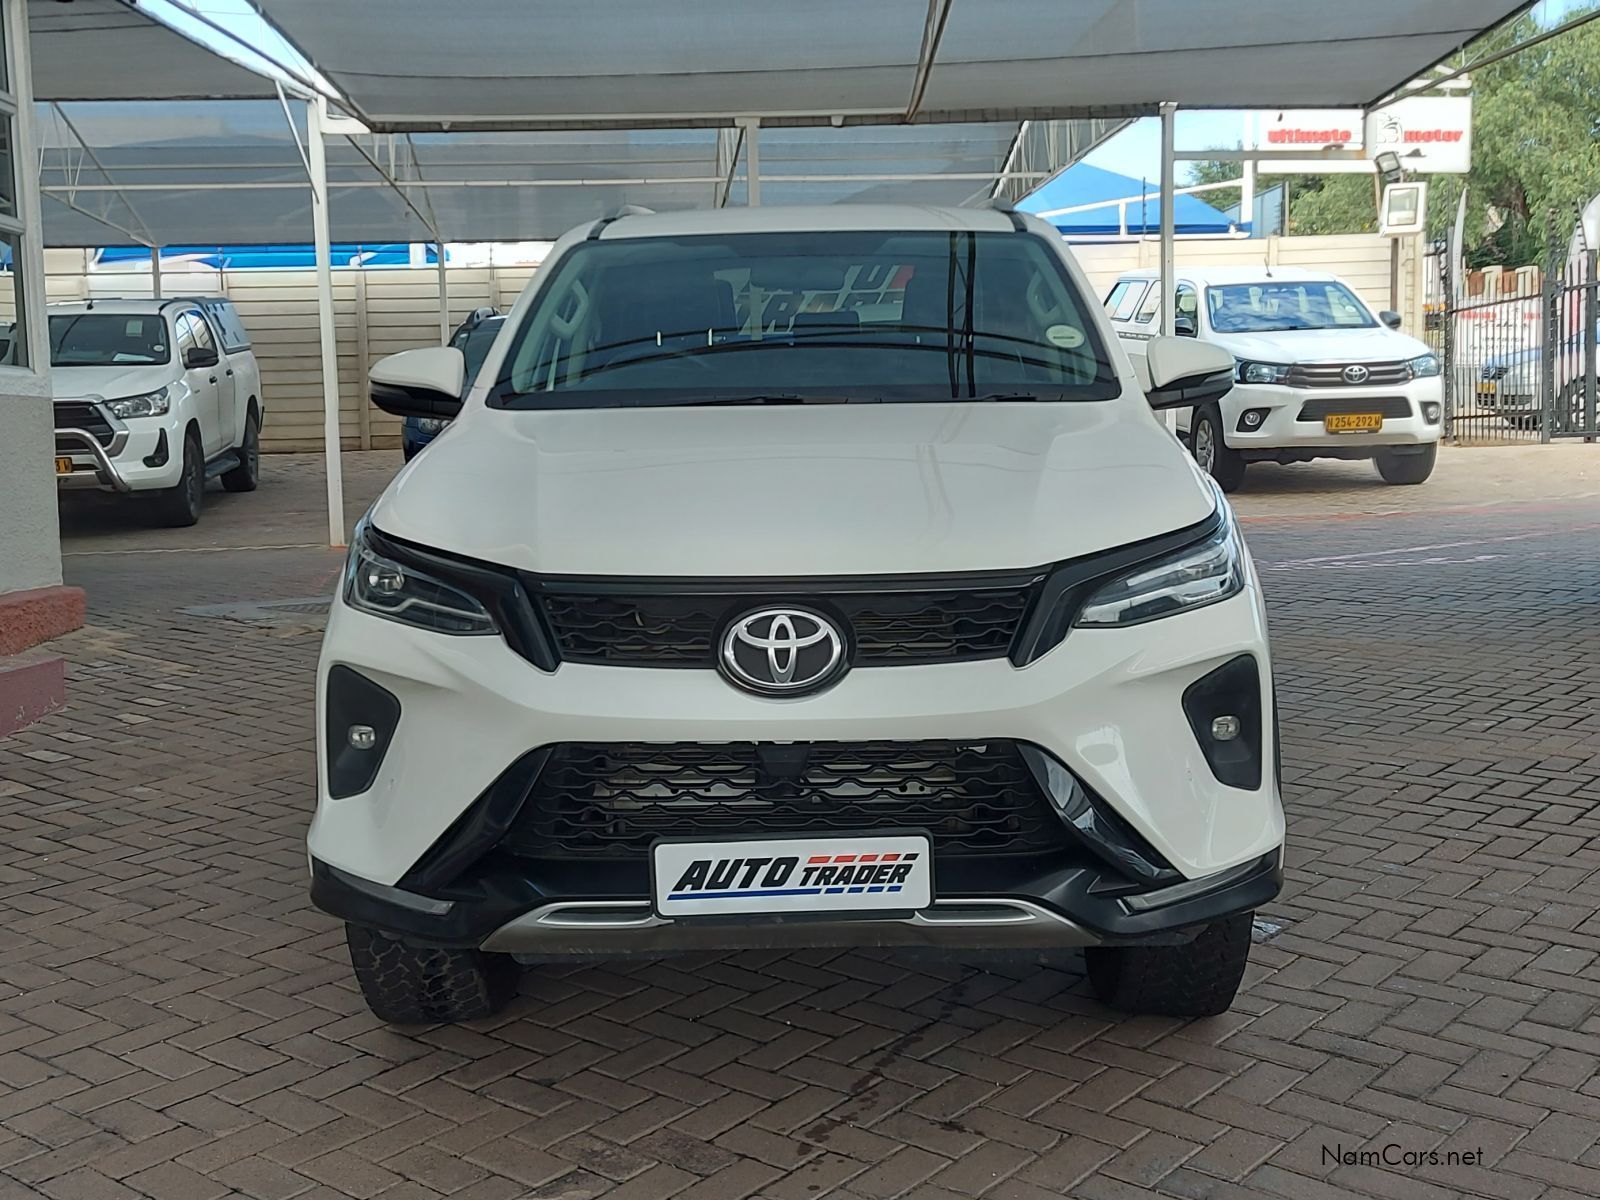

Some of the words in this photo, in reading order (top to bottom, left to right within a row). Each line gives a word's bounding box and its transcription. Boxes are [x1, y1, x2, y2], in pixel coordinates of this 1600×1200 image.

[1268, 128, 1351, 143] ultimate
[1404, 129, 1463, 143] motor
[672, 857, 800, 891] AUTO
[800, 864, 913, 886] TRADER
